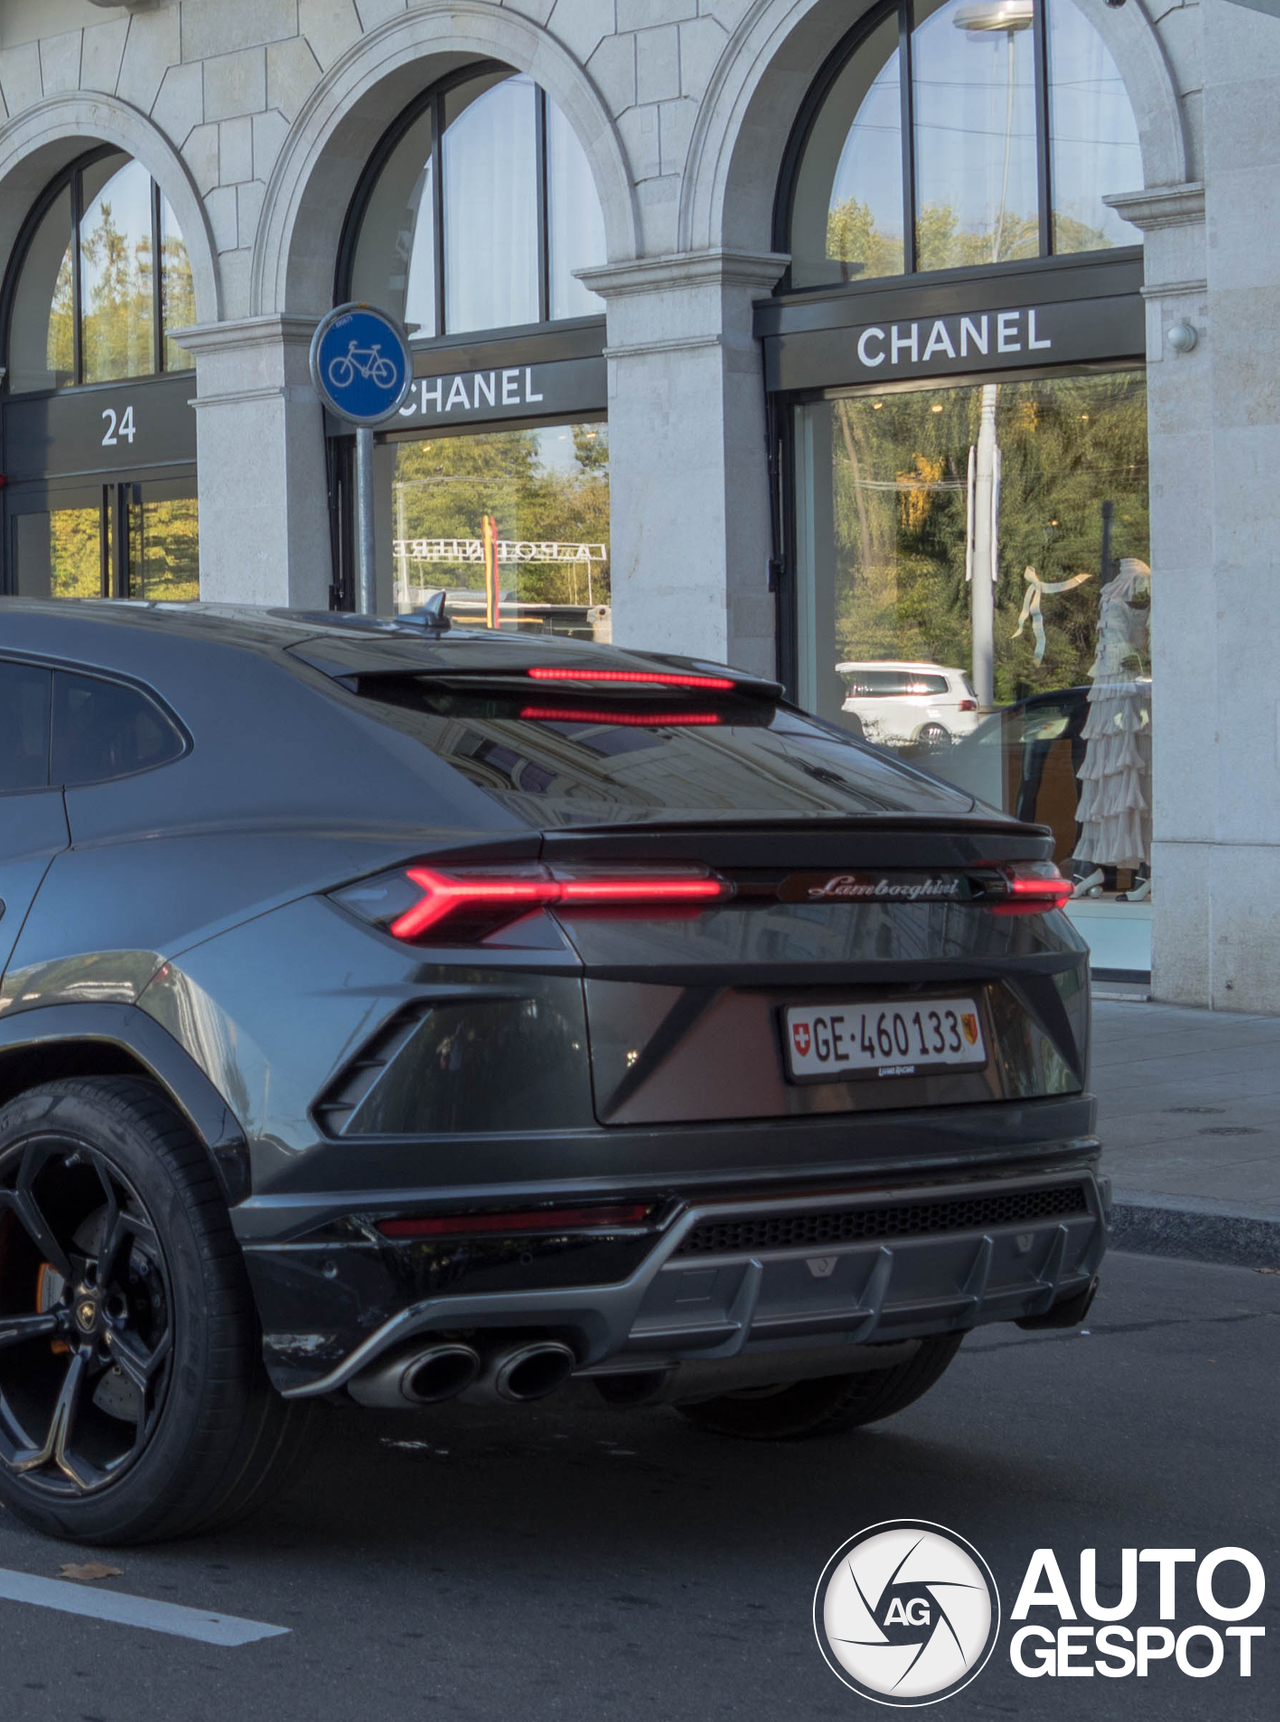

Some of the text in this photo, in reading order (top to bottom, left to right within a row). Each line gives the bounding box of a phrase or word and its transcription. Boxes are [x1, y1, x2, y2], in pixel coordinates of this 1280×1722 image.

[857, 310, 1051, 367] CHANEL
[101, 405, 137, 447] 24
[808, 875, 959, 900] Lamborghini
